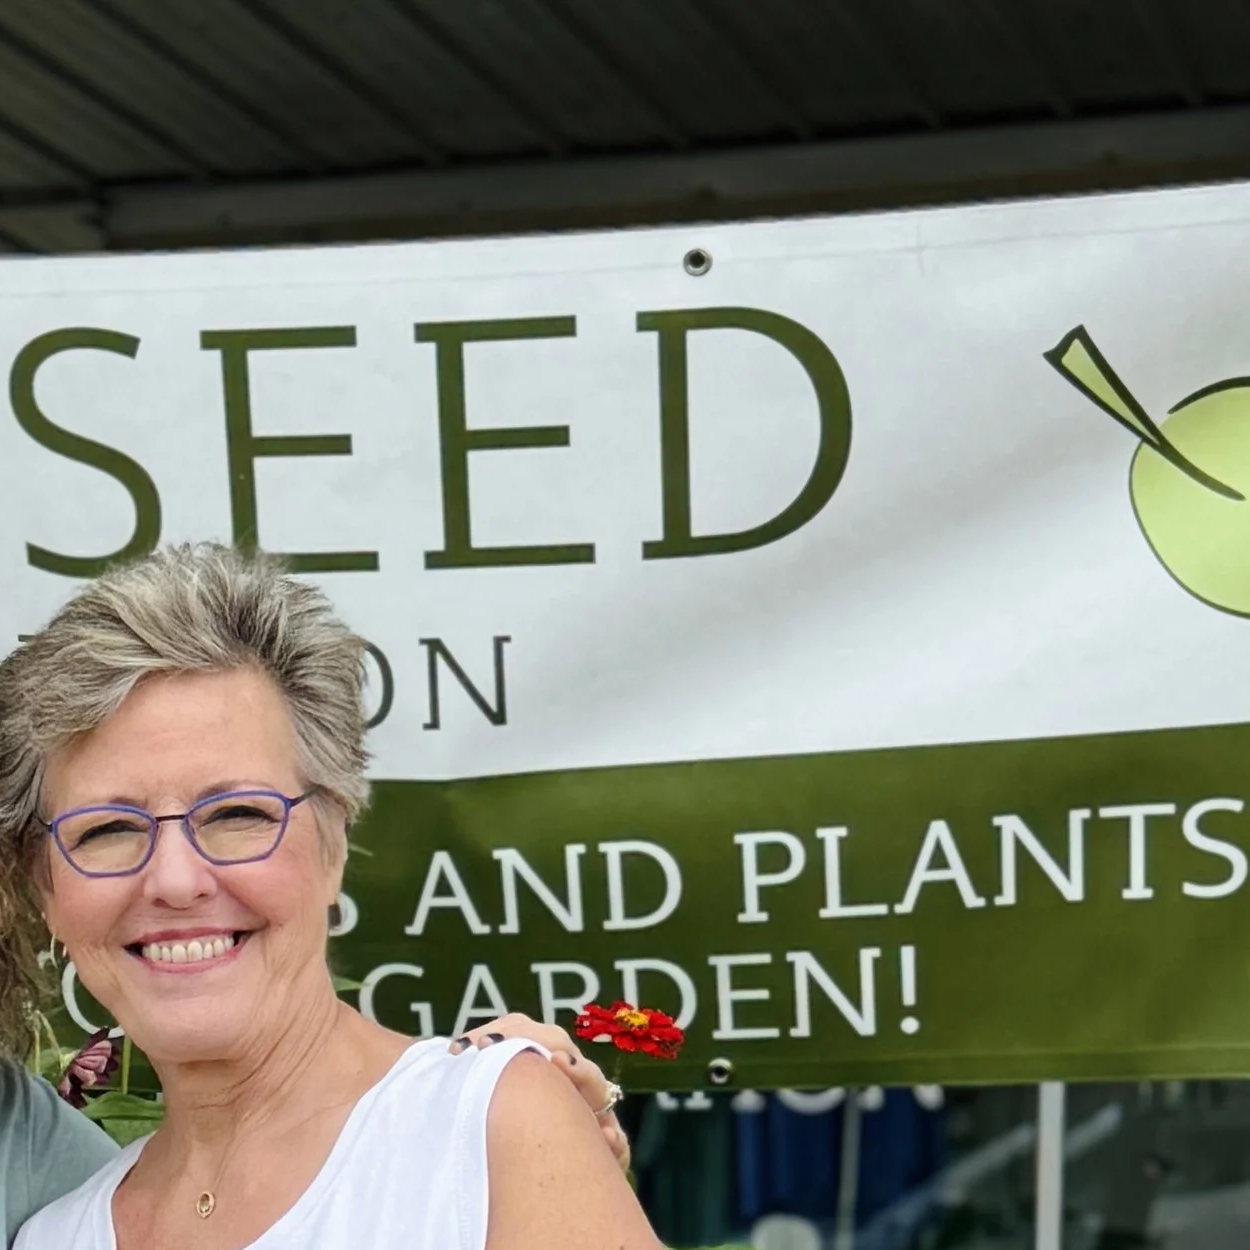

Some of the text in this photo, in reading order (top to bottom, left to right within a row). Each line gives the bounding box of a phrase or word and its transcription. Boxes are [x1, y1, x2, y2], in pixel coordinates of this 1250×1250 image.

[9, 306, 853, 578] SEED
[405, 841, 682, 935] AND
[734, 798, 1249, 923] PLANTS
[358, 946, 920, 1042] GARDEN!
